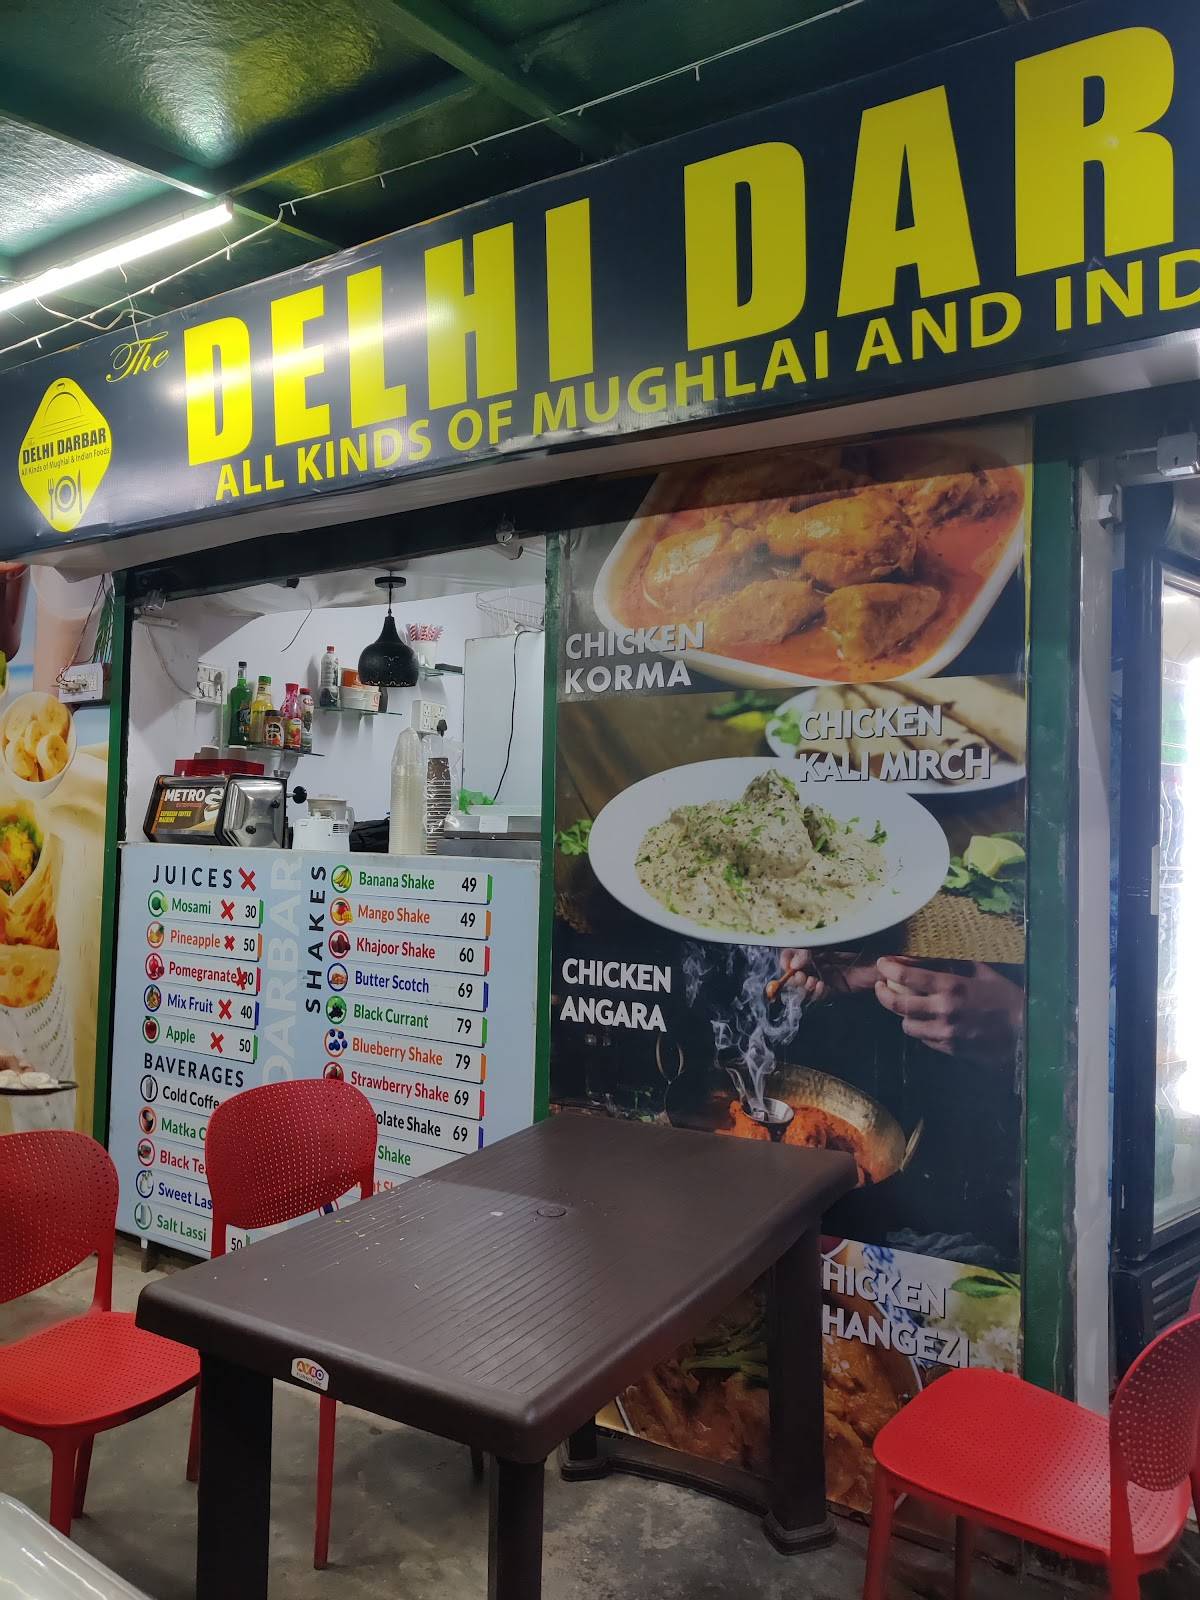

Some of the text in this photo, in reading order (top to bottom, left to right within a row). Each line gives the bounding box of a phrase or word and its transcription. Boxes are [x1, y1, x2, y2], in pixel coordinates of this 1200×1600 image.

[106, 26, 1174, 466] The DELHI DAR
[216, 249, 1200, 500] ALL KINDS OF MUGHLAI AND IND
[23, 428, 106, 464] DELHI DARBAR
[565, 621, 705, 660] CHICKEN
[564, 661, 692, 694] KORMA
[799, 705, 942, 741] CHICKEN
[799, 748, 990, 783] KALI MIRCH
[164, 789, 205, 802] METRO
[152, 865, 232, 888] JUICES
[359, 872, 477, 892] Banana Shake 49
[171, 898, 257, 918] Mosami 30
[358, 904, 476, 927] Mango Shake 49
[170, 930, 255, 952] Pineapple 50
[305, 866, 326, 1013] SHAKES
[356, 937, 474, 963] Khajoor Shake 60
[169, 961, 237, 983] Pomegranate
[355, 971, 473, 998] Butter Scotch 69
[561, 957, 672, 993] CHICKEN
[167, 994, 252, 1019] Mix Fruit 40
[354, 1004, 472, 1034] Black Currant 79
[559, 996, 668, 1032] ANGARA
[166, 1025, 251, 1053] Apple 50
[352, 1037, 471, 1069] Blueberry Shake 79
[144, 1053, 244, 1087] BAVERAGES
[162, 1086, 187, 1103] Cold
[351, 1071, 469, 1106] Strawberry Shake 69
[161, 1117, 196, 1139] Matka
[374, 1111, 468, 1142] olate Shake 69
[160, 1150, 206, 1174] Black Te
[377, 1145, 411, 1165] Shake
[158, 1182, 192, 1204] Sweet
[157, 1214, 242, 1251] Salt Lassi 50
[822, 1260, 946, 1318] HICKEN
